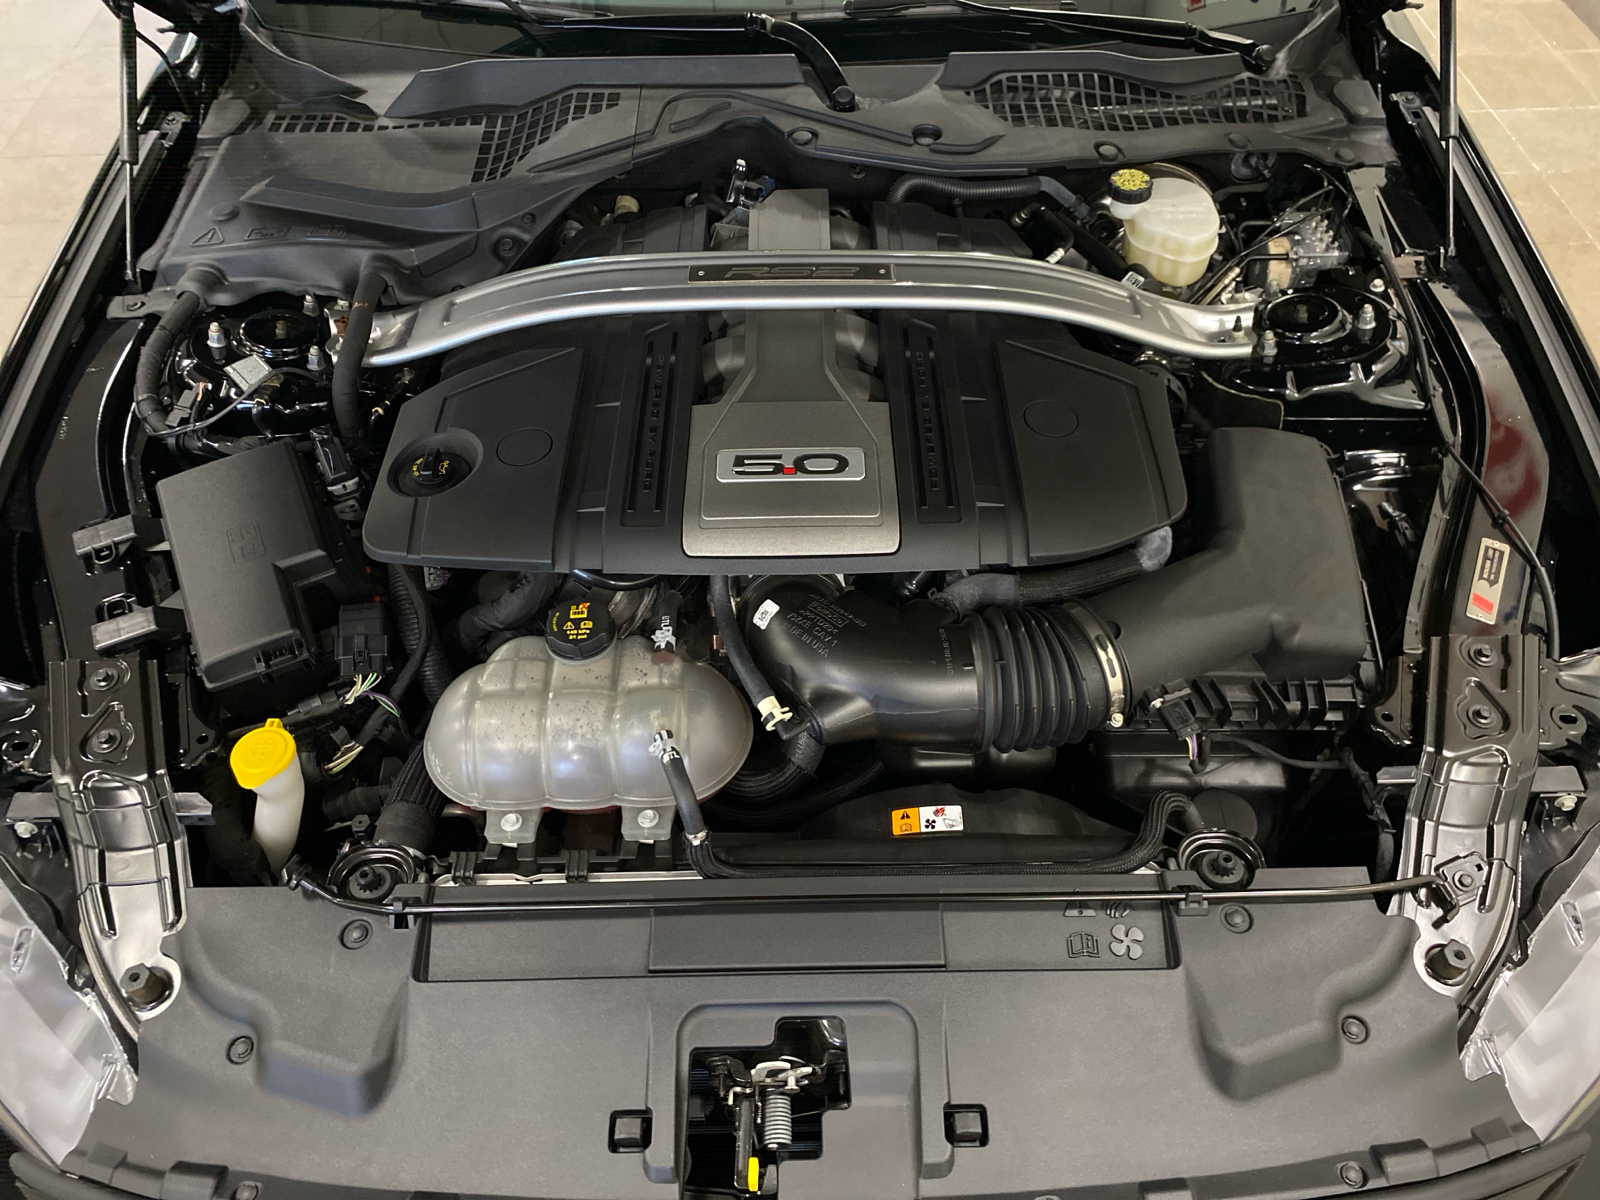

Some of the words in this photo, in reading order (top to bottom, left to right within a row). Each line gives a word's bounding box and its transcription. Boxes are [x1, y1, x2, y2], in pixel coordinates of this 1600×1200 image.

[916, 350, 928, 388] FORD
[650, 353, 665, 420] POWERED
[921, 394, 930, 411] BY
[648, 423, 657, 444] BY
[732, 453, 850, 476] 5.0
[924, 414, 940, 491] POWERED
[643, 449, 656, 493] FORD
[811, 603, 844, 625] FoMoCo
[801, 632, 813, 645] IN
[812, 640, 830, 657] USA
[813, 627, 833, 642] CAV
